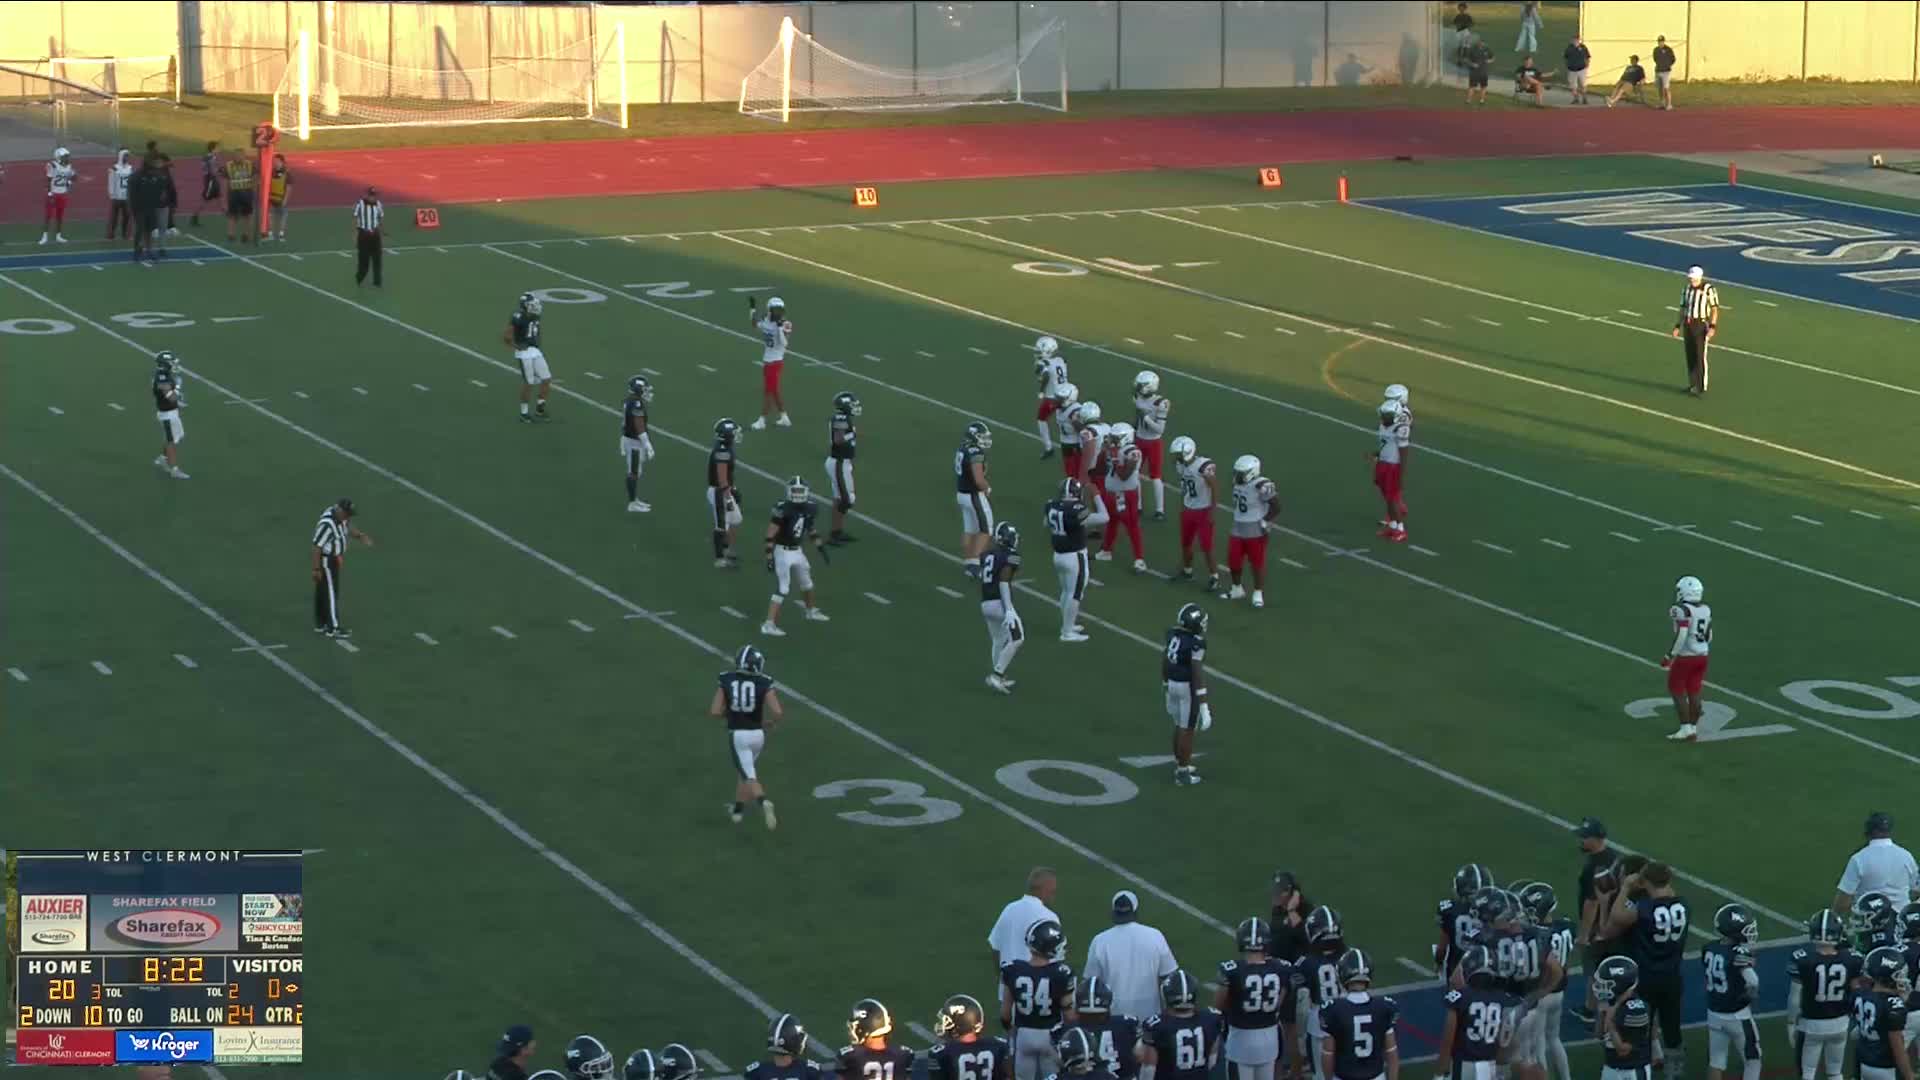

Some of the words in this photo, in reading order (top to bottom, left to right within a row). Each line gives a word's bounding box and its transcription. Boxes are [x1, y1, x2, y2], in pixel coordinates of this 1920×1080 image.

[1266, 170, 1275, 181] G
[860, 189, 875, 201] 10
[418, 210, 436, 222] 20
[1500, 191, 1920, 283] WES
[793, 517, 805, 537] 4
[1048, 508, 1066, 536] 51
[731, 681, 756, 713] 10
[1624, 680, 1920, 742] 20
[814, 759, 1139, 826] 30
[87, 851, 131, 862] WEST
[142, 851, 240, 862] CLERMONT
[26, 899, 83, 913] AUXIER
[113, 898, 177, 907] SHAREFAX
[181, 898, 216, 906] FIELD
[126, 920, 205, 932] Sharefax
[1653, 902, 1686, 942] 99
[28, 960, 92, 974] HOME
[145, 957, 203, 981] 8:22
[232, 959, 302, 972] VISITOR
[1704, 950, 1728, 993] 39
[49, 979, 75, 999] 20
[91, 984, 100, 1000] 3
[106, 988, 122, 997] TOL
[206, 987, 222, 996] TOL
[228, 983, 238, 999] 2
[1815, 963, 1847, 1002] 12
[1015, 975, 1053, 1017] 34
[1243, 973, 1280, 1013] 33
[21, 1005, 33, 1026] 2
[36, 1008, 71, 1024] DOWN
[84, 1005, 102, 1026] 10
[107, 1008, 122, 1023] TO
[127, 1008, 143, 1023] GO
[170, 1008, 200, 1023] BALL
[206, 1008, 223, 1023] ON
[228, 1005, 253, 1024] 24
[266, 1007, 293, 1023] QTR
[1467, 1001, 1501, 1044] 38
[152, 1032, 199, 1058] Kroger
[1353, 1015, 1373, 1058] 5
[26, 1050, 72, 1058] CINCINNATI
[75, 1050, 111, 1058] CLERMONT
[1176, 1026, 1206, 1070] 61
[957, 1052, 994, 1080] 63
